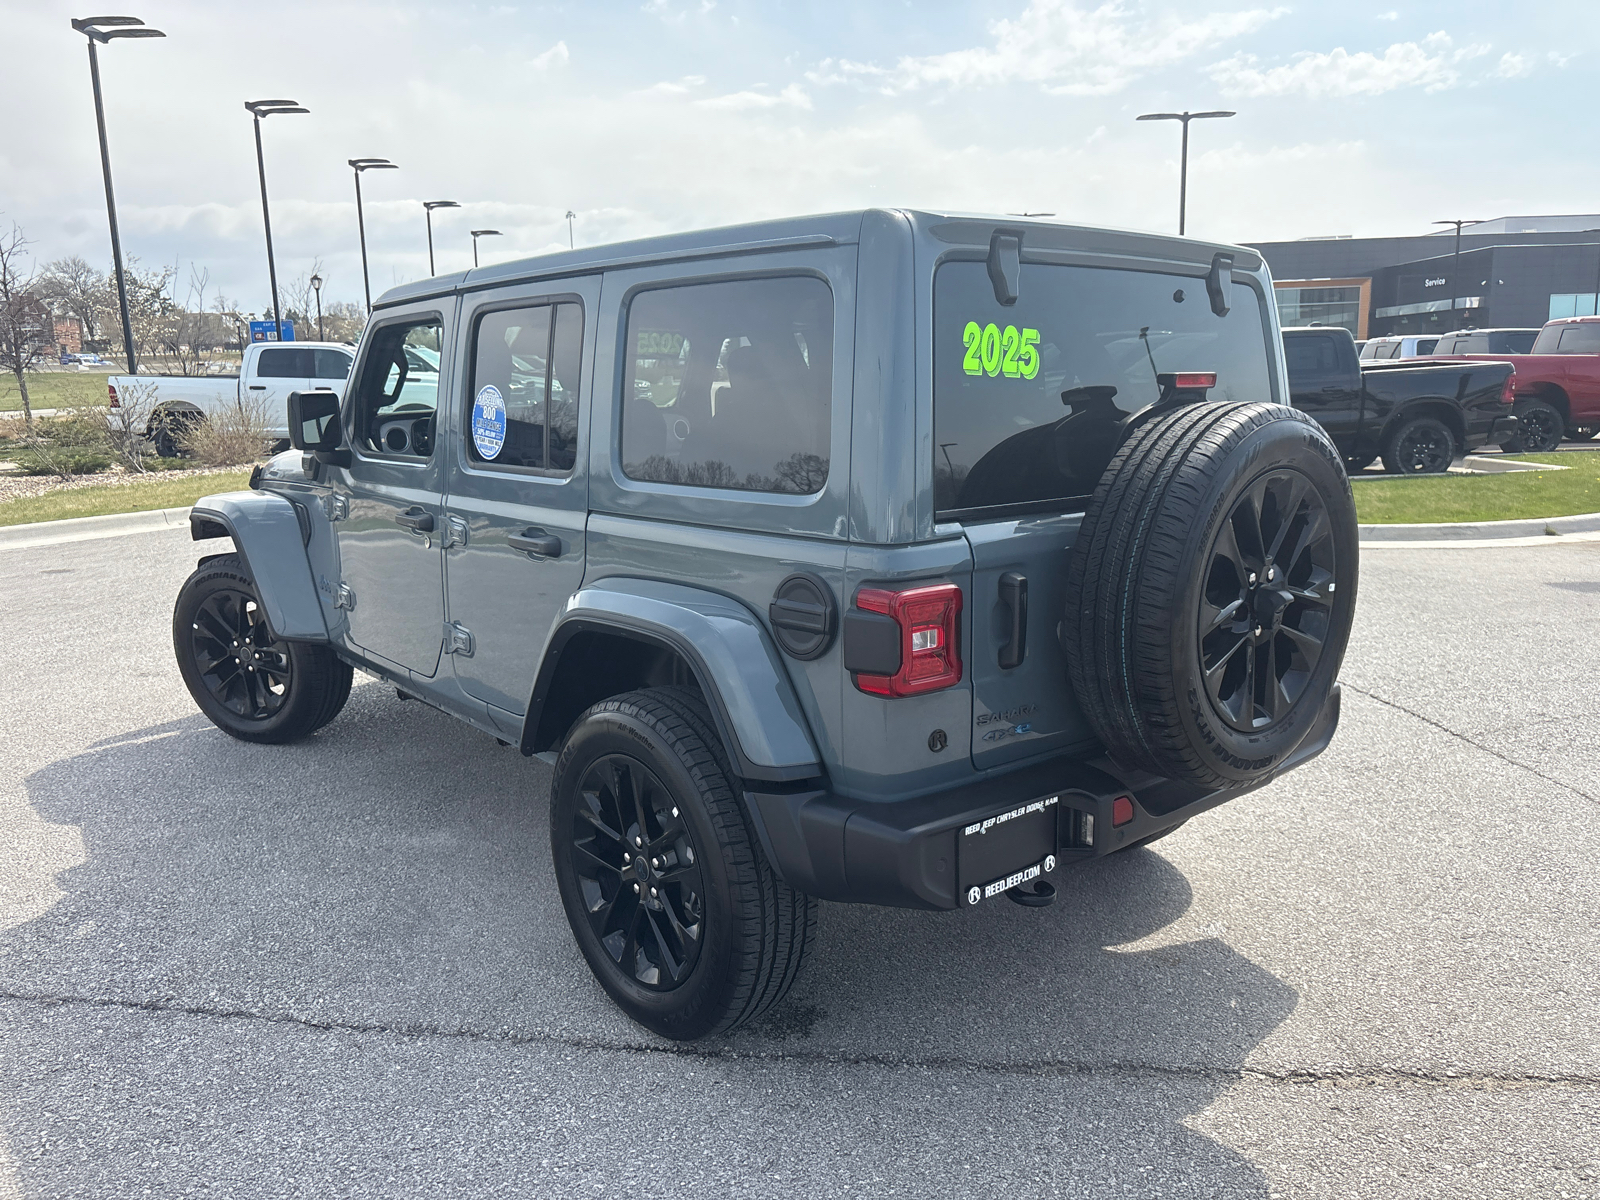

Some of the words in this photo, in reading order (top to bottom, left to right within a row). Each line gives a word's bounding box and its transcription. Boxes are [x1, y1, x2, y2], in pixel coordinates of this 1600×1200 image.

[1424, 277, 1446, 288] Service
[963, 321, 1040, 380] 2025
[476, 417, 487, 428] MILE
[487, 419, 502, 432] RANGE
[482, 405, 496, 421] 800
[195, 571, 238, 588] ROADIAN
[976, 703, 1038, 726] SAHARA
[617, 722, 656, 751] All-Weather
[1211, 743, 1274, 771] ROADIAN
[964, 822, 981, 836] REED
[982, 817, 996, 829] JEEP
[996, 806, 1026, 824] CHRYSLER
[1025, 800, 1045, 813] DODGE
[1044, 796, 1059, 807] RAM
[984, 864, 1041, 899] REEDJEEP.COM
